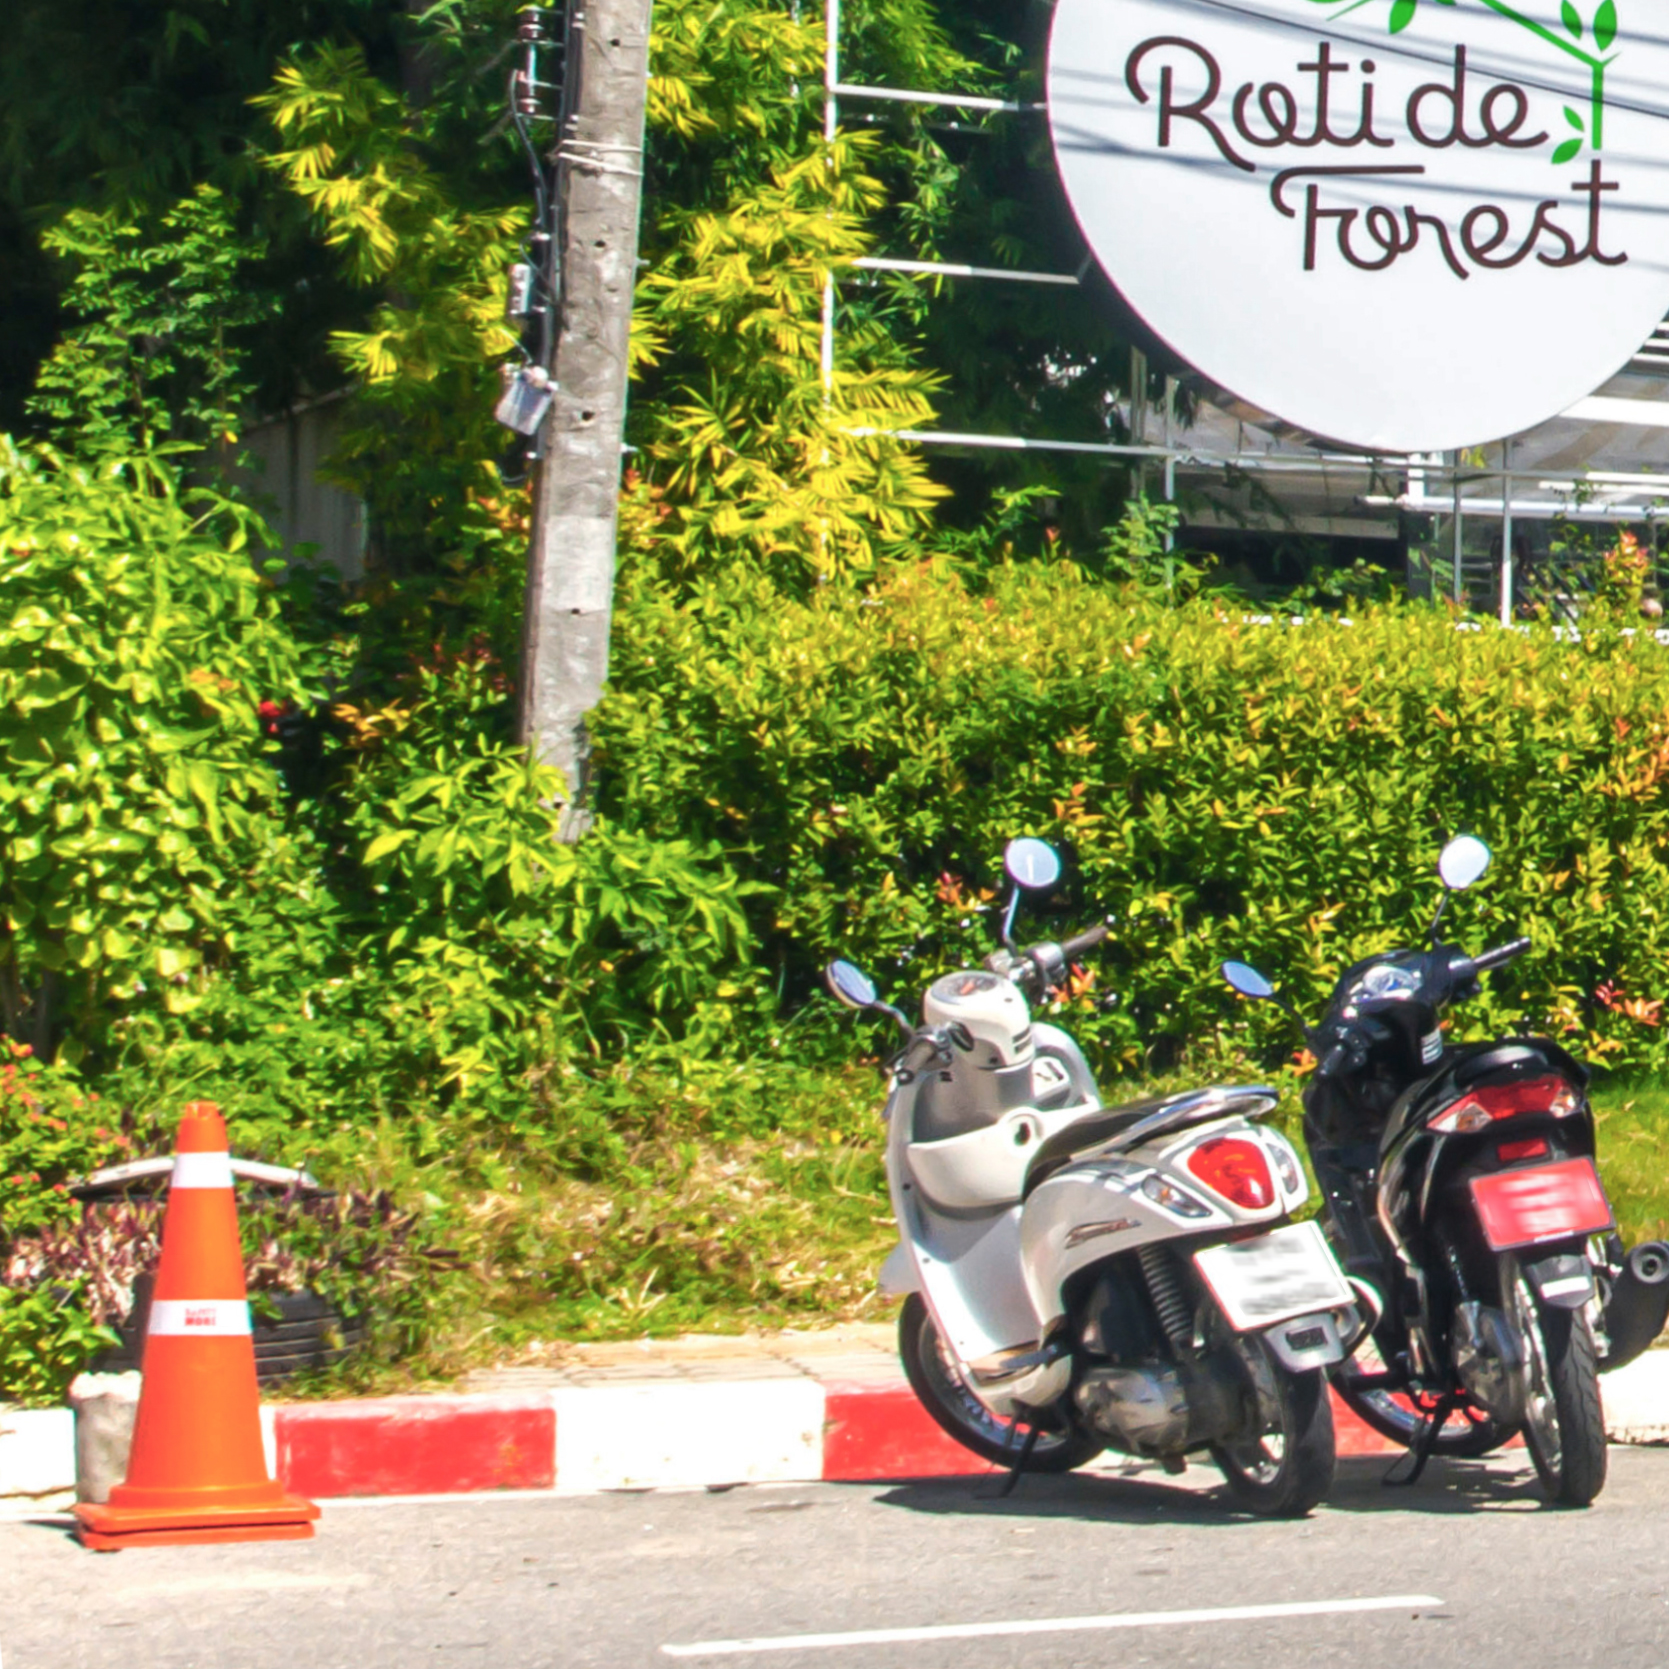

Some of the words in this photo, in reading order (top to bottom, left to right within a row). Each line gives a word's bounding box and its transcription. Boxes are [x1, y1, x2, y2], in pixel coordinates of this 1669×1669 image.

[1124, 35, 1396, 173] Roti
[1405, 43, 1550, 149] de
[1270, 159, 1628, 281] Forest
